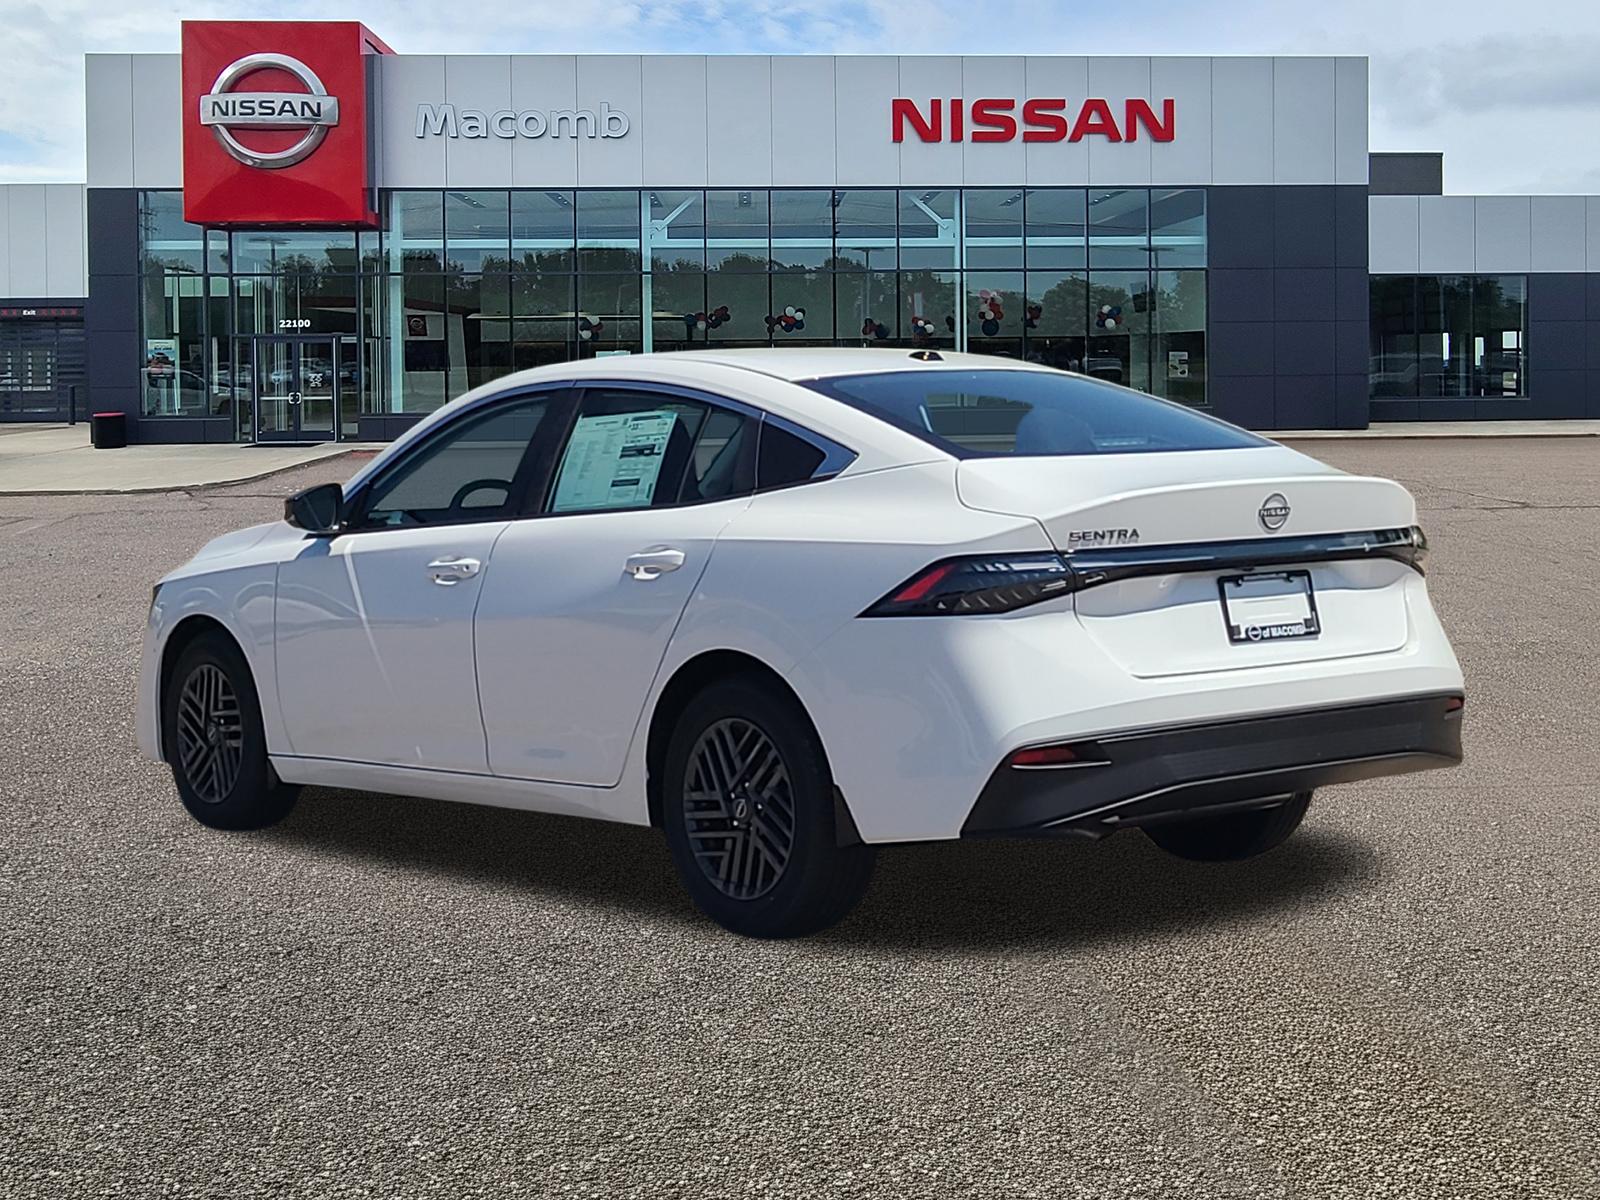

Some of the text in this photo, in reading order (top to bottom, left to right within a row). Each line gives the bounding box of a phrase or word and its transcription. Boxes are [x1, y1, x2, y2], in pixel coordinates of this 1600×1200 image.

[212, 100, 322, 118] NISSAN
[415, 102, 630, 138] Macomb
[893, 98, 1175, 143] NISSAN
[279, 319, 311, 328] 22100
[1069, 528, 1139, 542] SENTRA
